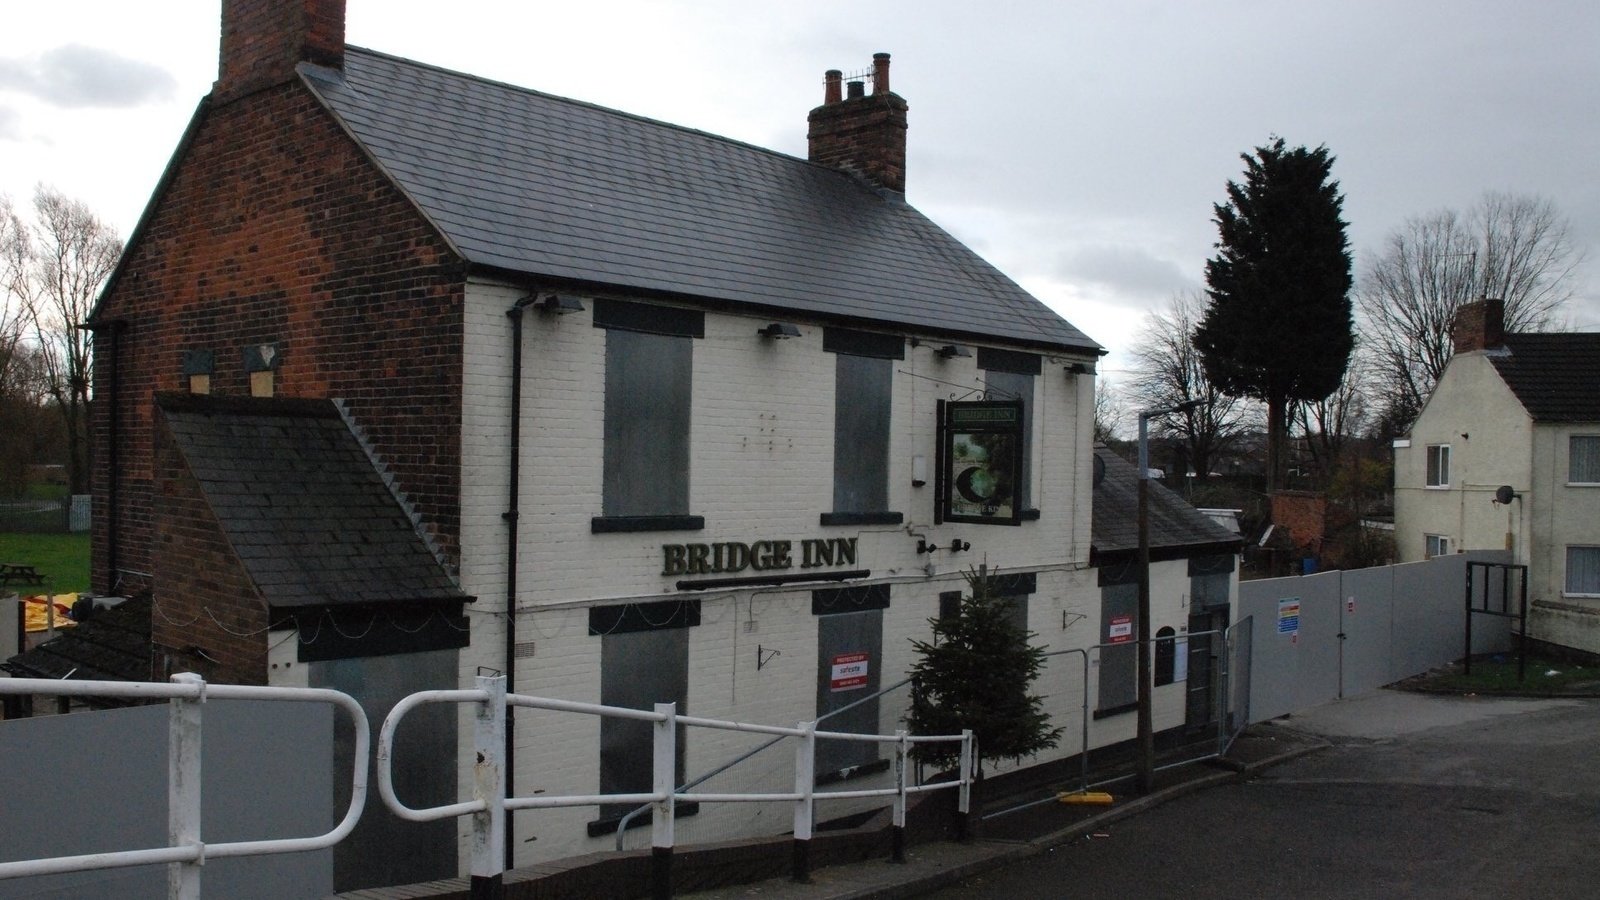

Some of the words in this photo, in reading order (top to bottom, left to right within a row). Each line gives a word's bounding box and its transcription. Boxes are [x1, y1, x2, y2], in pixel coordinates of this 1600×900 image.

[994, 410, 1010, 419] INN
[662, 540, 792, 576] BRIDGE
[801, 537, 858, 568] INN
